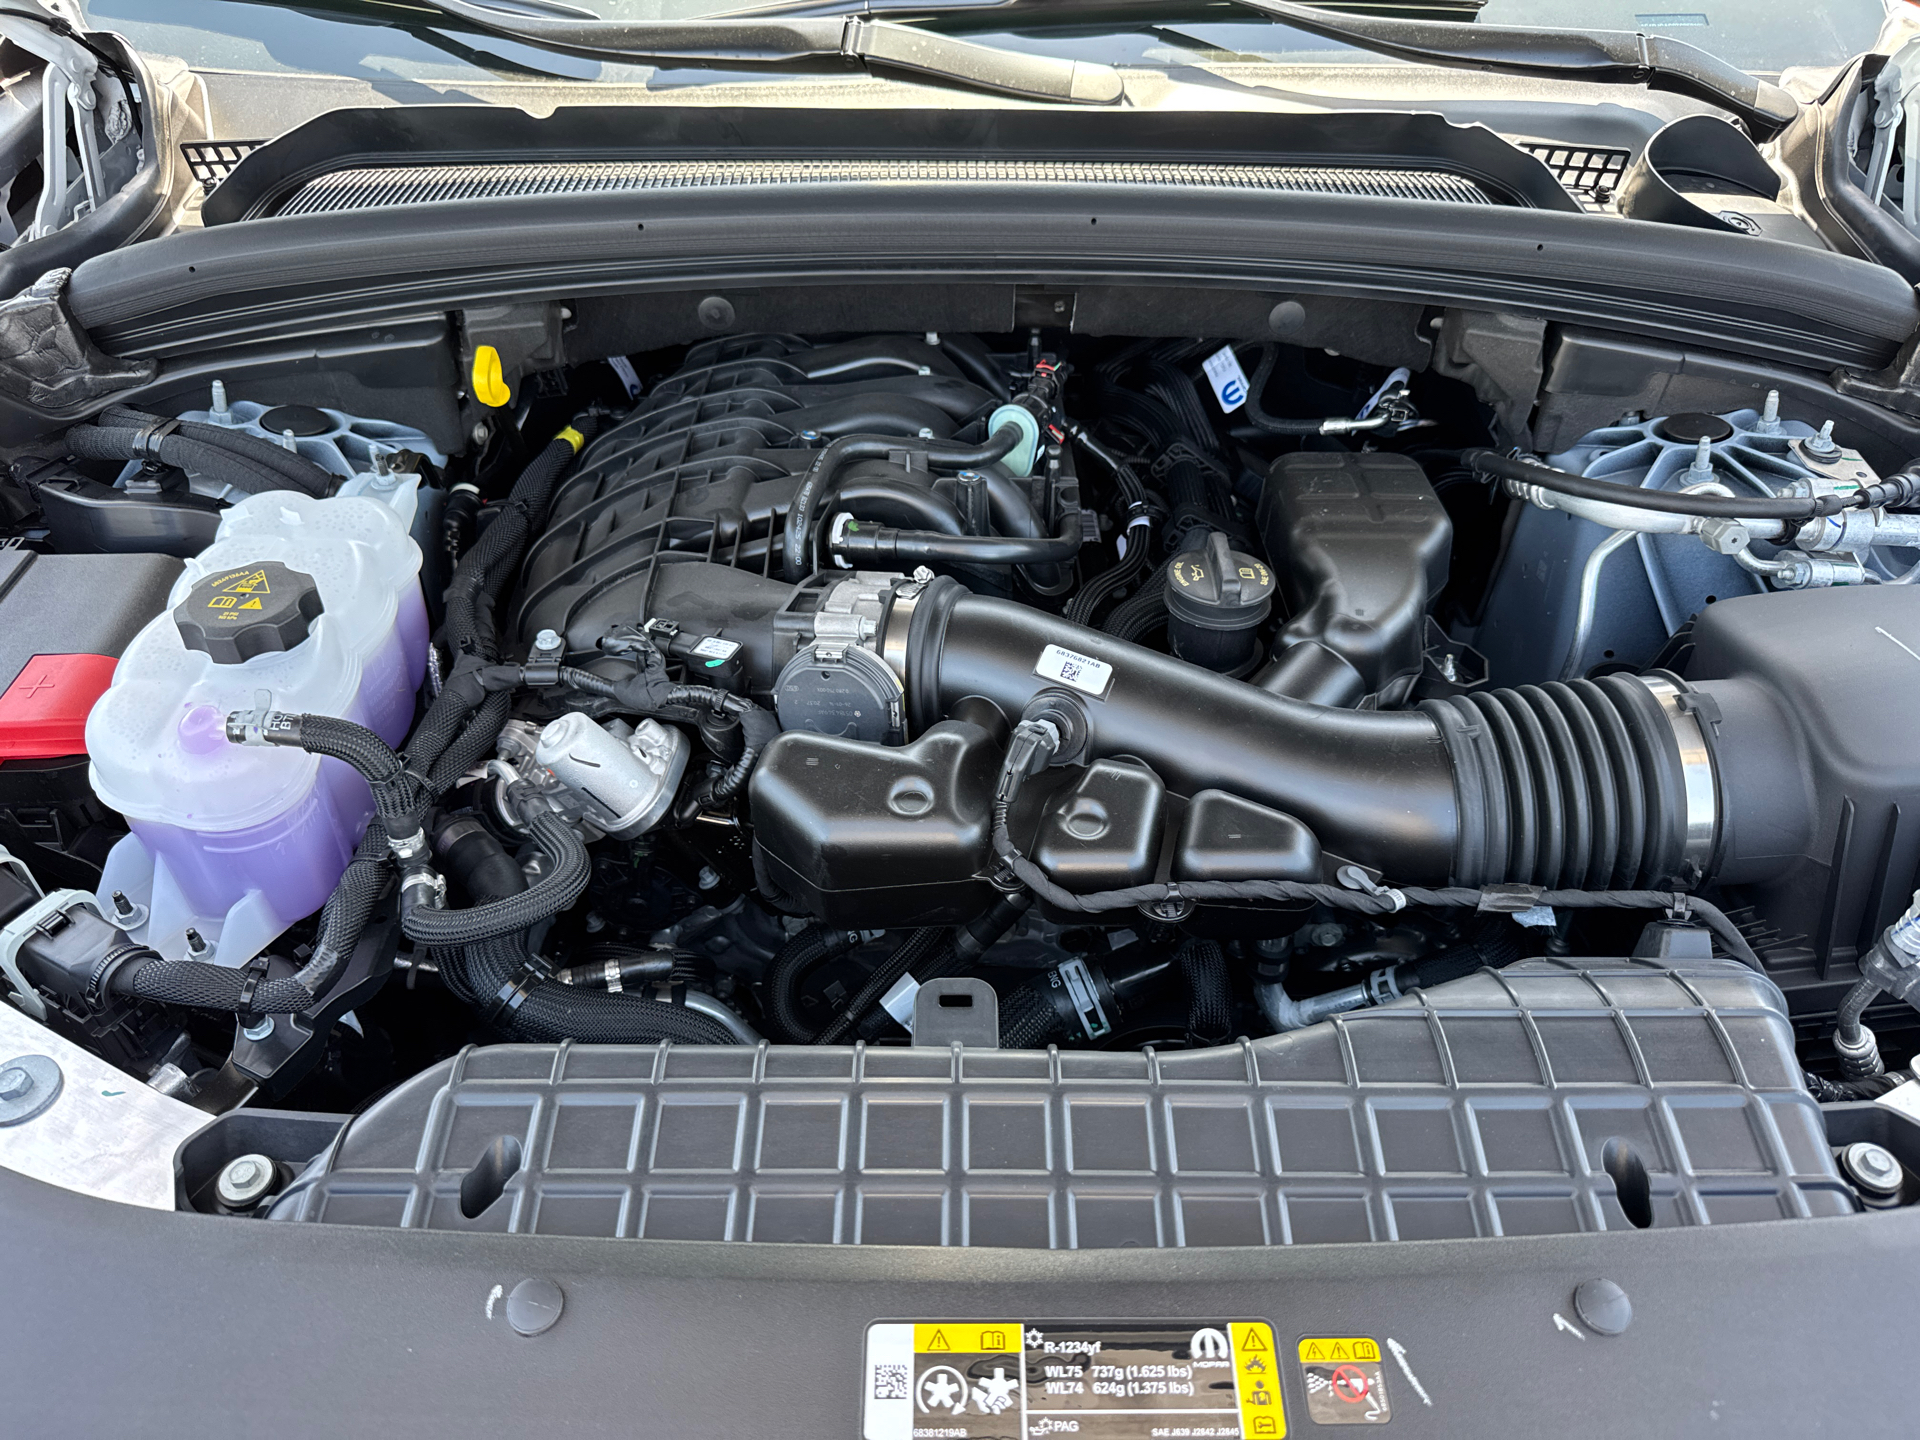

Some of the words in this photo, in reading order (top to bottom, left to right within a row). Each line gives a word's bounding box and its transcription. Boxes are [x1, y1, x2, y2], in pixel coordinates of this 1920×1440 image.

[1044, 1341, 1101, 1356] R-1234yf
[1044, 1365, 1083, 1377] WL75
[1091, 1365, 1124, 1380] 737g
[1126, 1365, 1165, 1380] (1.625
[1167, 1365, 1193, 1380] lbs)
[1045, 1382, 1084, 1394] WL74
[1092, 1382, 1125, 1397] 624g
[1127, 1381, 1167, 1397] (1.375
[1168, 1381, 1195, 1397] lbs)
[913, 1428, 968, 1437] 68381219AB
[1053, 1420, 1080, 1432] PAG
[1151, 1427, 1170, 1437] SAE
[1170, 1427, 1190, 1437] J639
